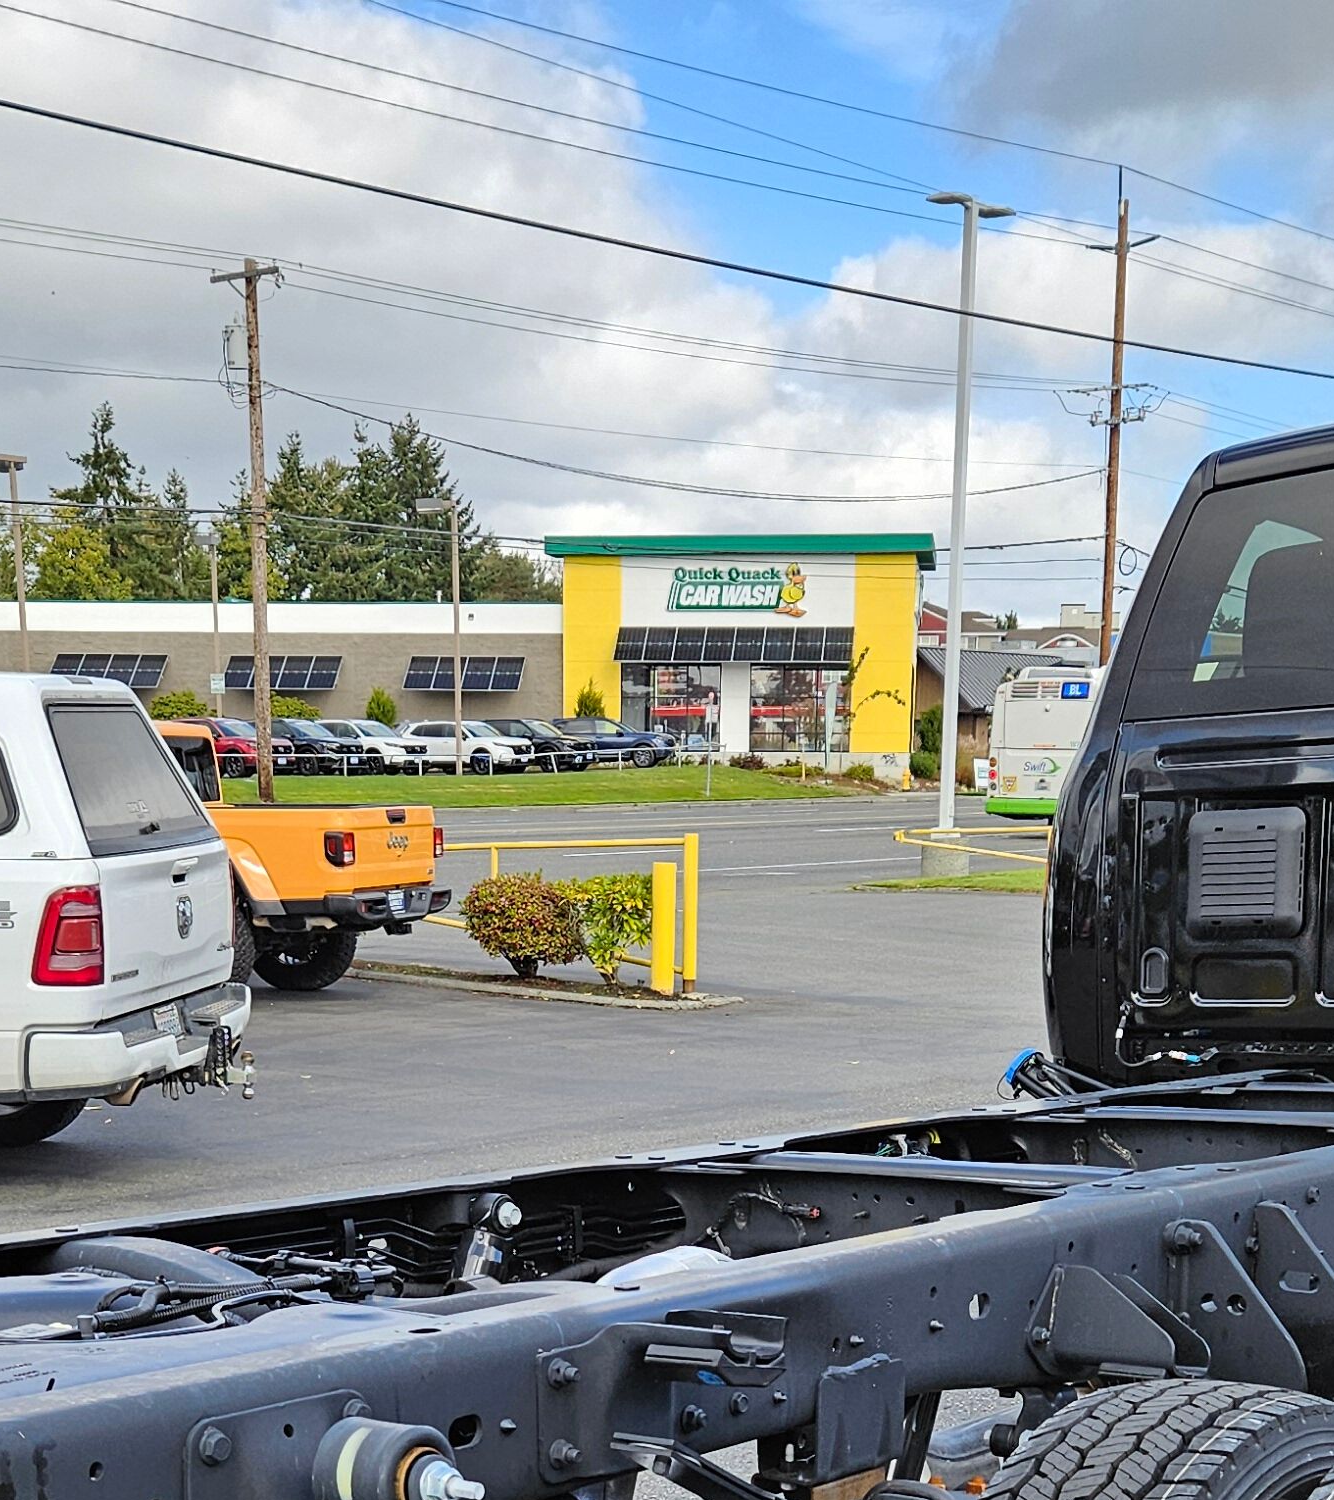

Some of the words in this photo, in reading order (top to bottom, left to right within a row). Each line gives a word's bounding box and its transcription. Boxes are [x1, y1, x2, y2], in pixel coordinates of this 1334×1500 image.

[674, 566, 724, 582] Quick
[728, 566, 781, 582] Quack
[679, 584, 720, 606] CAR
[722, 584, 780, 606] WASH
[1068, 684, 1082, 695] BL
[1023, 761, 1047, 772] Swift
